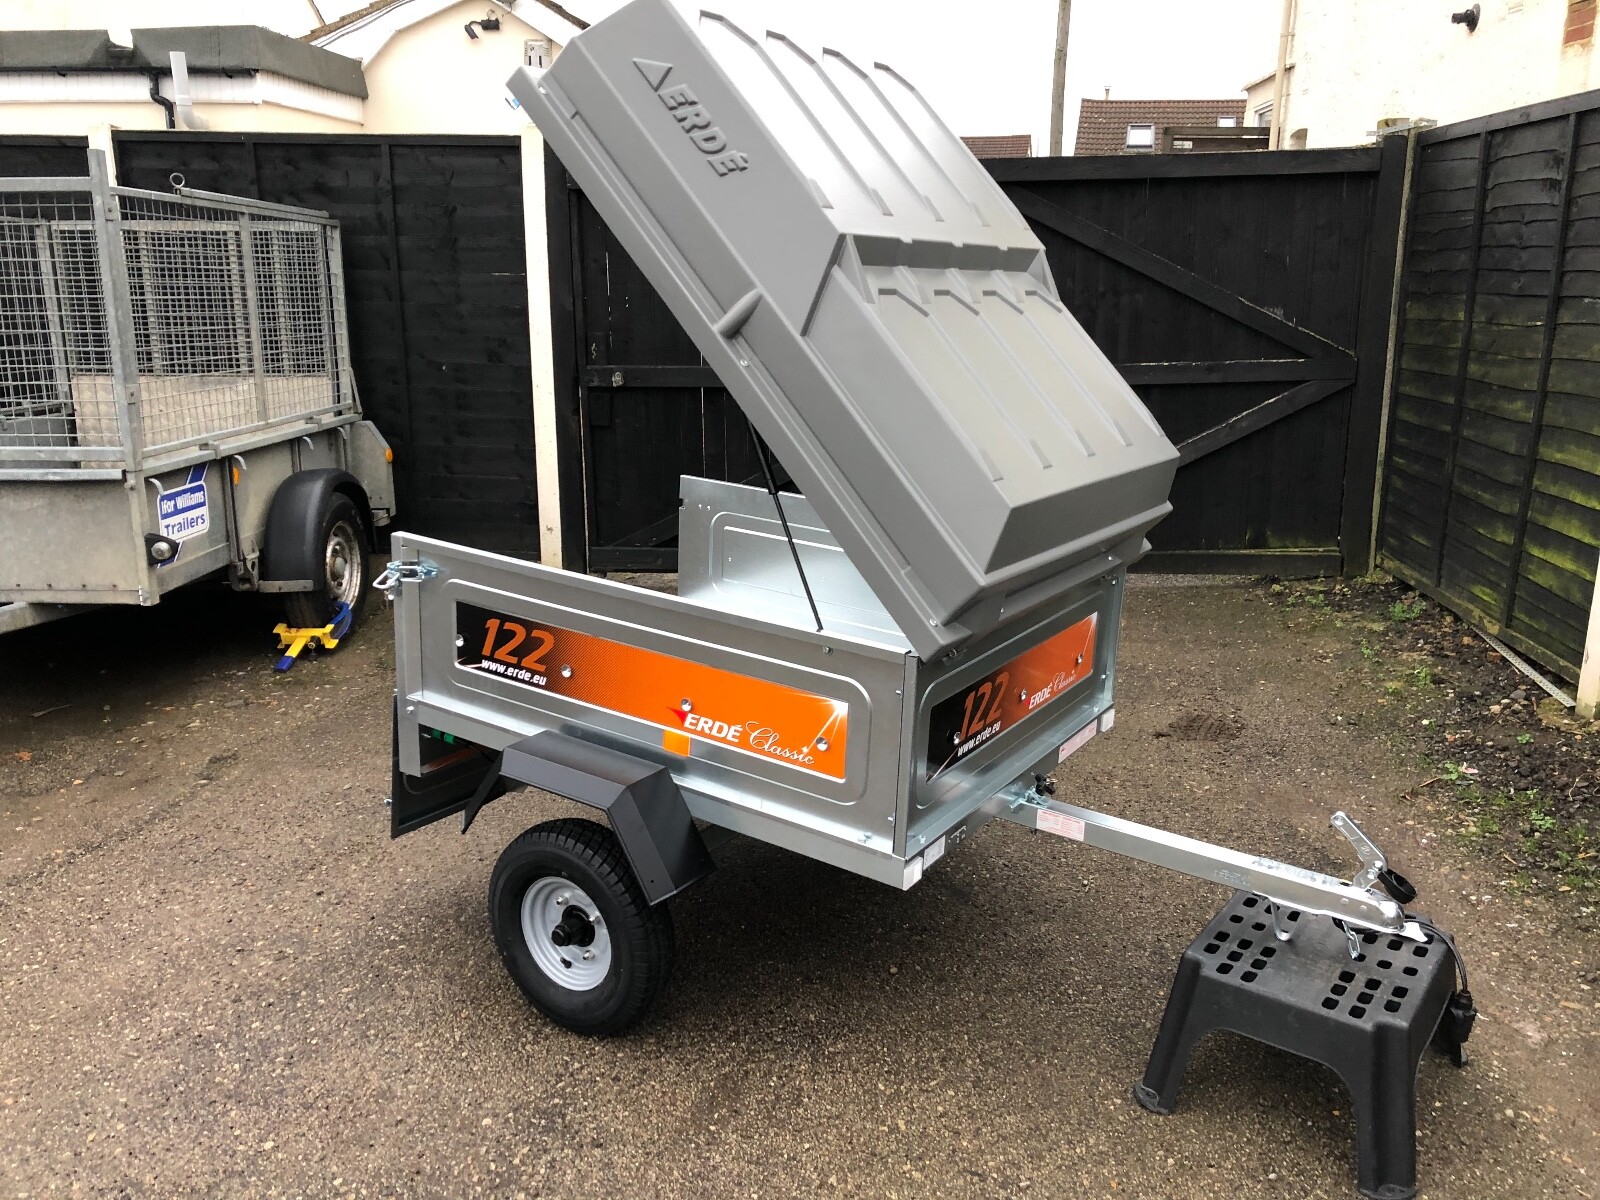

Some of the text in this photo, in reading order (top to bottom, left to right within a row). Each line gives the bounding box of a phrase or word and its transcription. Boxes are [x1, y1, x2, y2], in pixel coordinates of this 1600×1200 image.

[657, 83, 749, 177] ERDÉ
[161, 491, 204, 514] Ifor Williams
[164, 513, 205, 537] Trailers
[481, 618, 556, 672] 122
[481, 658, 548, 686] www.erde.eu
[1053, 670, 1077, 692] Classic
[959, 671, 1011, 742] 122
[684, 712, 815, 765] ERDÉ Classic
[957, 720, 1001, 757] www.erde.eu
